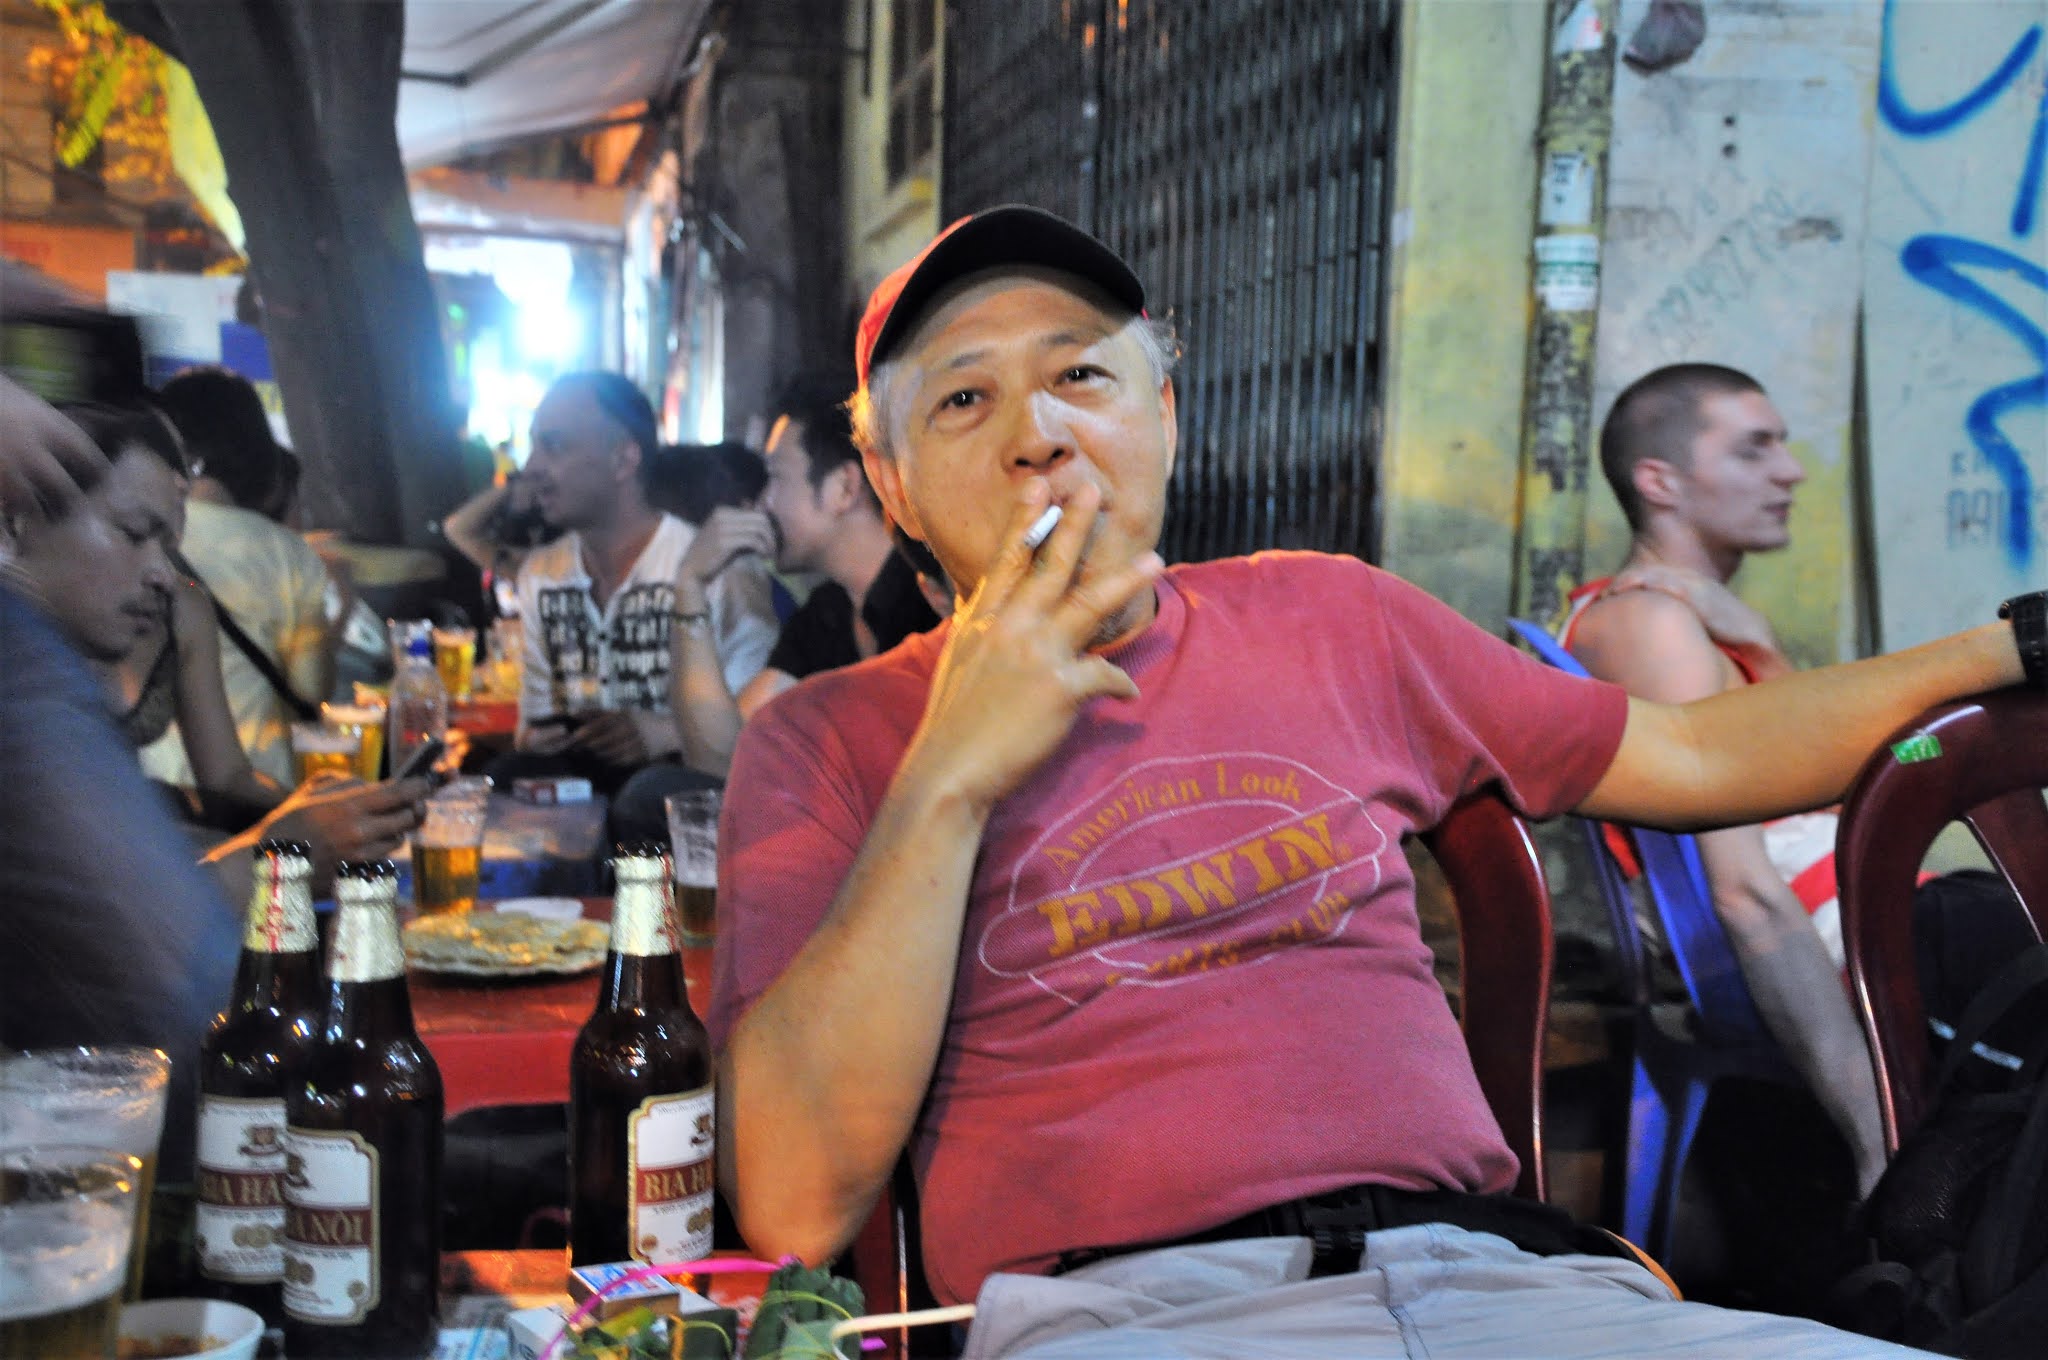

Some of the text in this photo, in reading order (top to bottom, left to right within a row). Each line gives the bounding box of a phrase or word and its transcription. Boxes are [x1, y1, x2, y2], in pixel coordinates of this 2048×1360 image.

[1040, 761, 1302, 877] American Look
[1036, 812, 1340, 958] EDWIN
